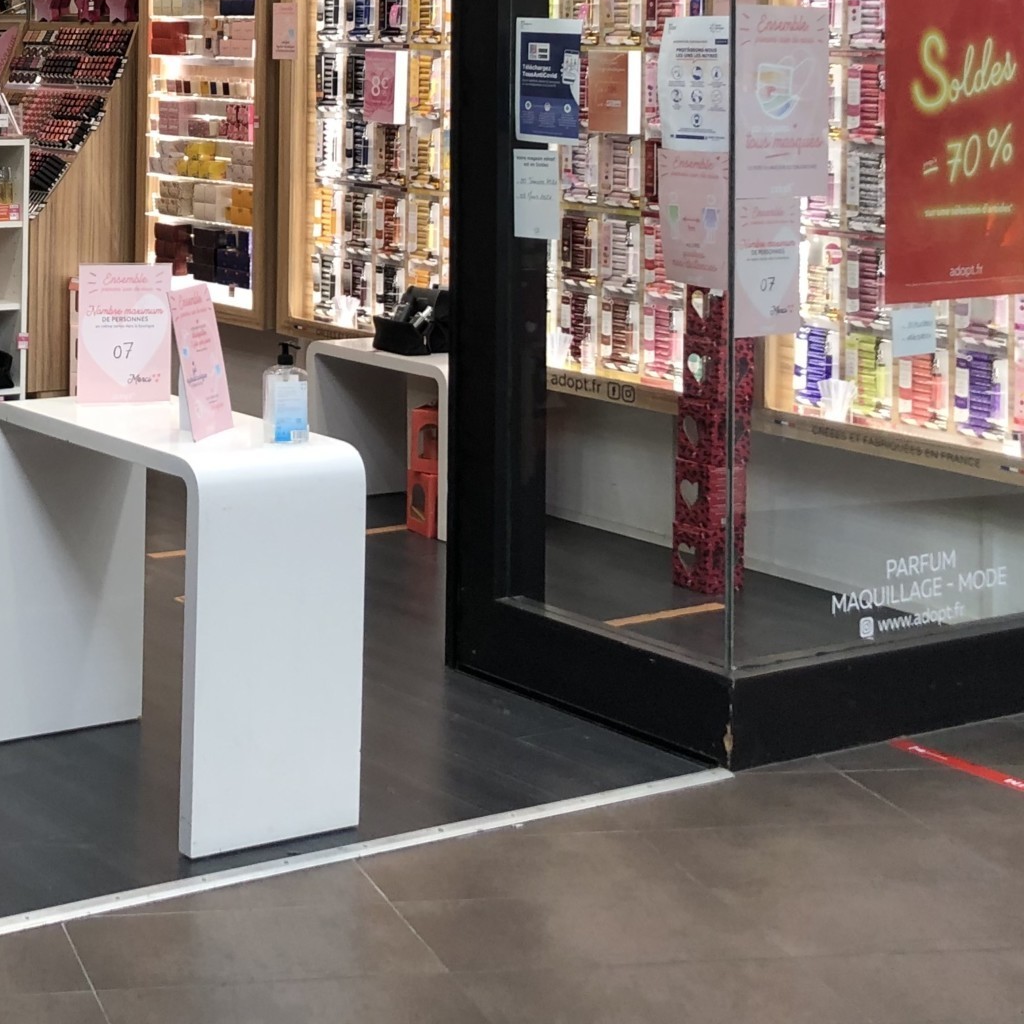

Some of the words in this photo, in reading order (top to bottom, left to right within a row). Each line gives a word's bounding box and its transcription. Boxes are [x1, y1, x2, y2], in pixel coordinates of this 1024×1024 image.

[912, 33, 1017, 111] Soldes
[949, 262, 984, 277] adopt.fr
[760, 276, 776, 293] 07
[112, 342, 134, 360] 07
[550, 373, 602, 394] adopt.fr
[925, 448, 939, 459] EN
[939, 451, 981, 468] FRANCE
[886, 549, 957, 580] PARFUM
[831, 577, 943, 616] MAQUILLAGE
[958, 566, 1007, 592] MODE
[877, 601, 966, 632] www.adopt.fr
